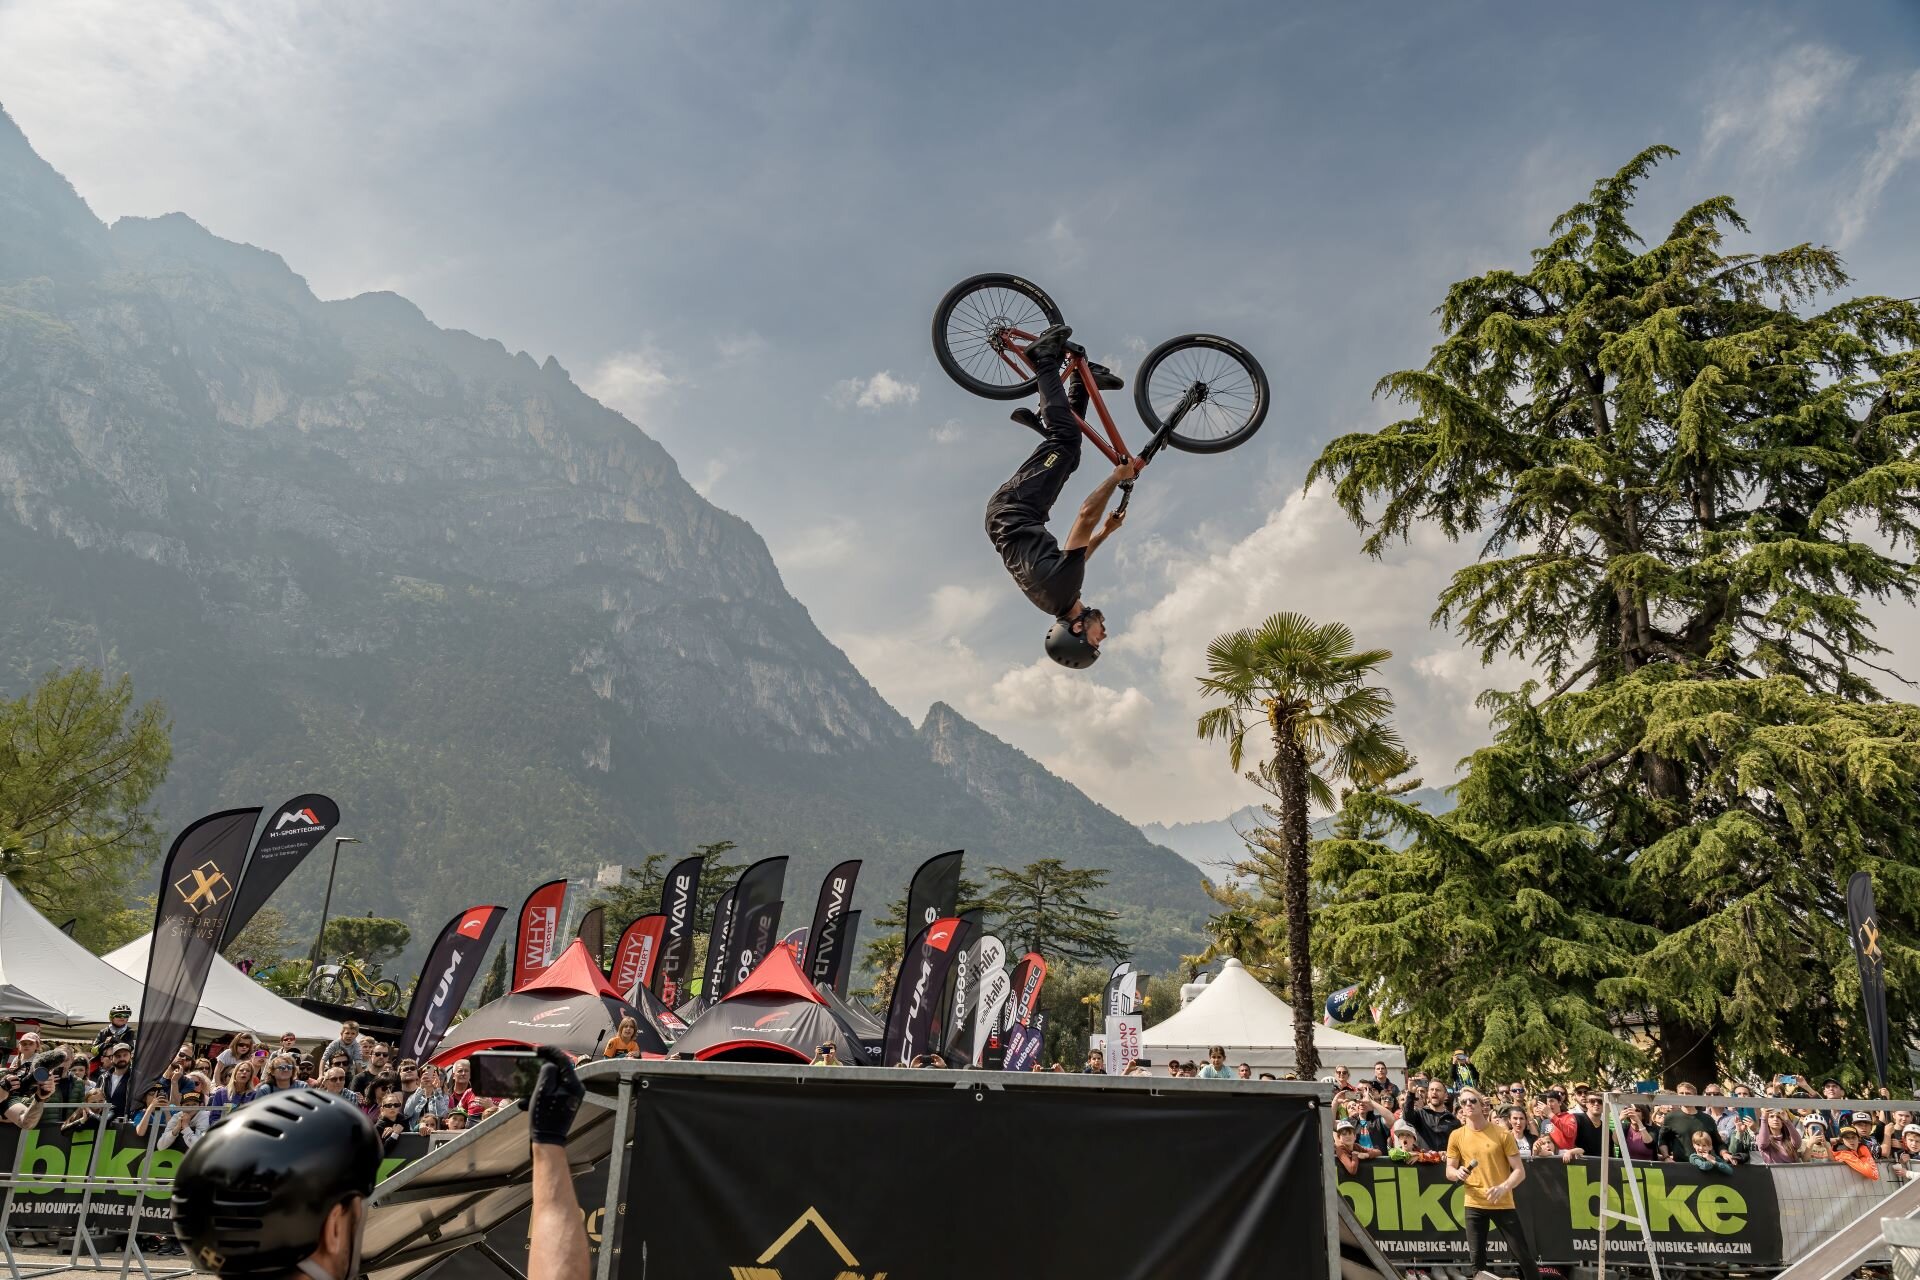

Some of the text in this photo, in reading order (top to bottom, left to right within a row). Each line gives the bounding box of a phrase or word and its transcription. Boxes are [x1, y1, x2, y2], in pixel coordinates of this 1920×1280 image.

[545, 920, 554, 954] SPORT
[970, 945, 1000, 982] italia
[984, 975, 1006, 1010] italia
[1016, 965, 1041, 1023] rgotec
[1120, 1022, 1130, 1070] UGANO
[1129, 1027, 1139, 1059] GION
[14, 1129, 186, 1200] bike
[9, 1202, 32, 1213] DAS
[1566, 1164, 1748, 1235] bike
[1572, 1239, 1598, 1251] DAS
